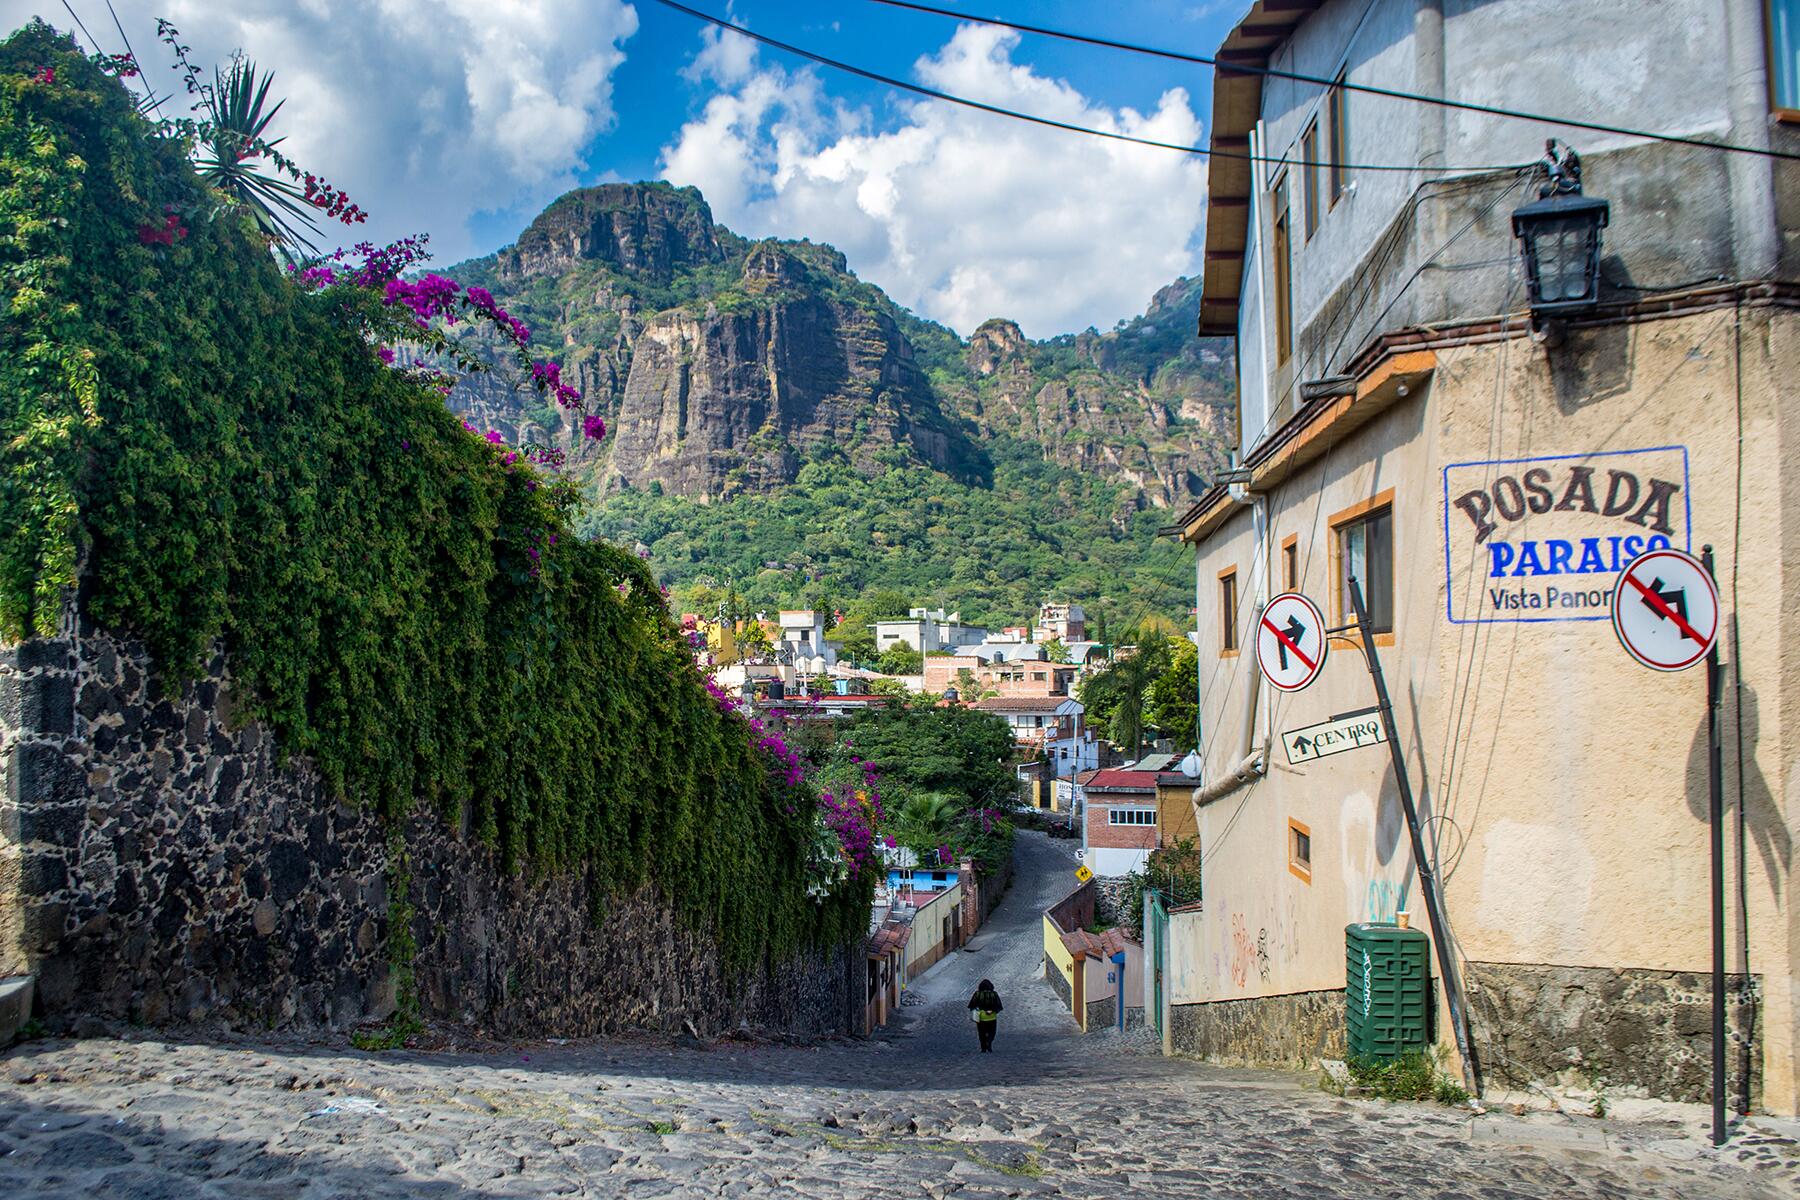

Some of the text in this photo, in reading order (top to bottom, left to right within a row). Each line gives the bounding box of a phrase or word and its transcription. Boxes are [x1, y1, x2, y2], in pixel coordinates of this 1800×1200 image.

[1453, 466, 1681, 544] POSADA
[1490, 589, 1541, 610] Vista
[1314, 720, 1379, 747] CENTRO
